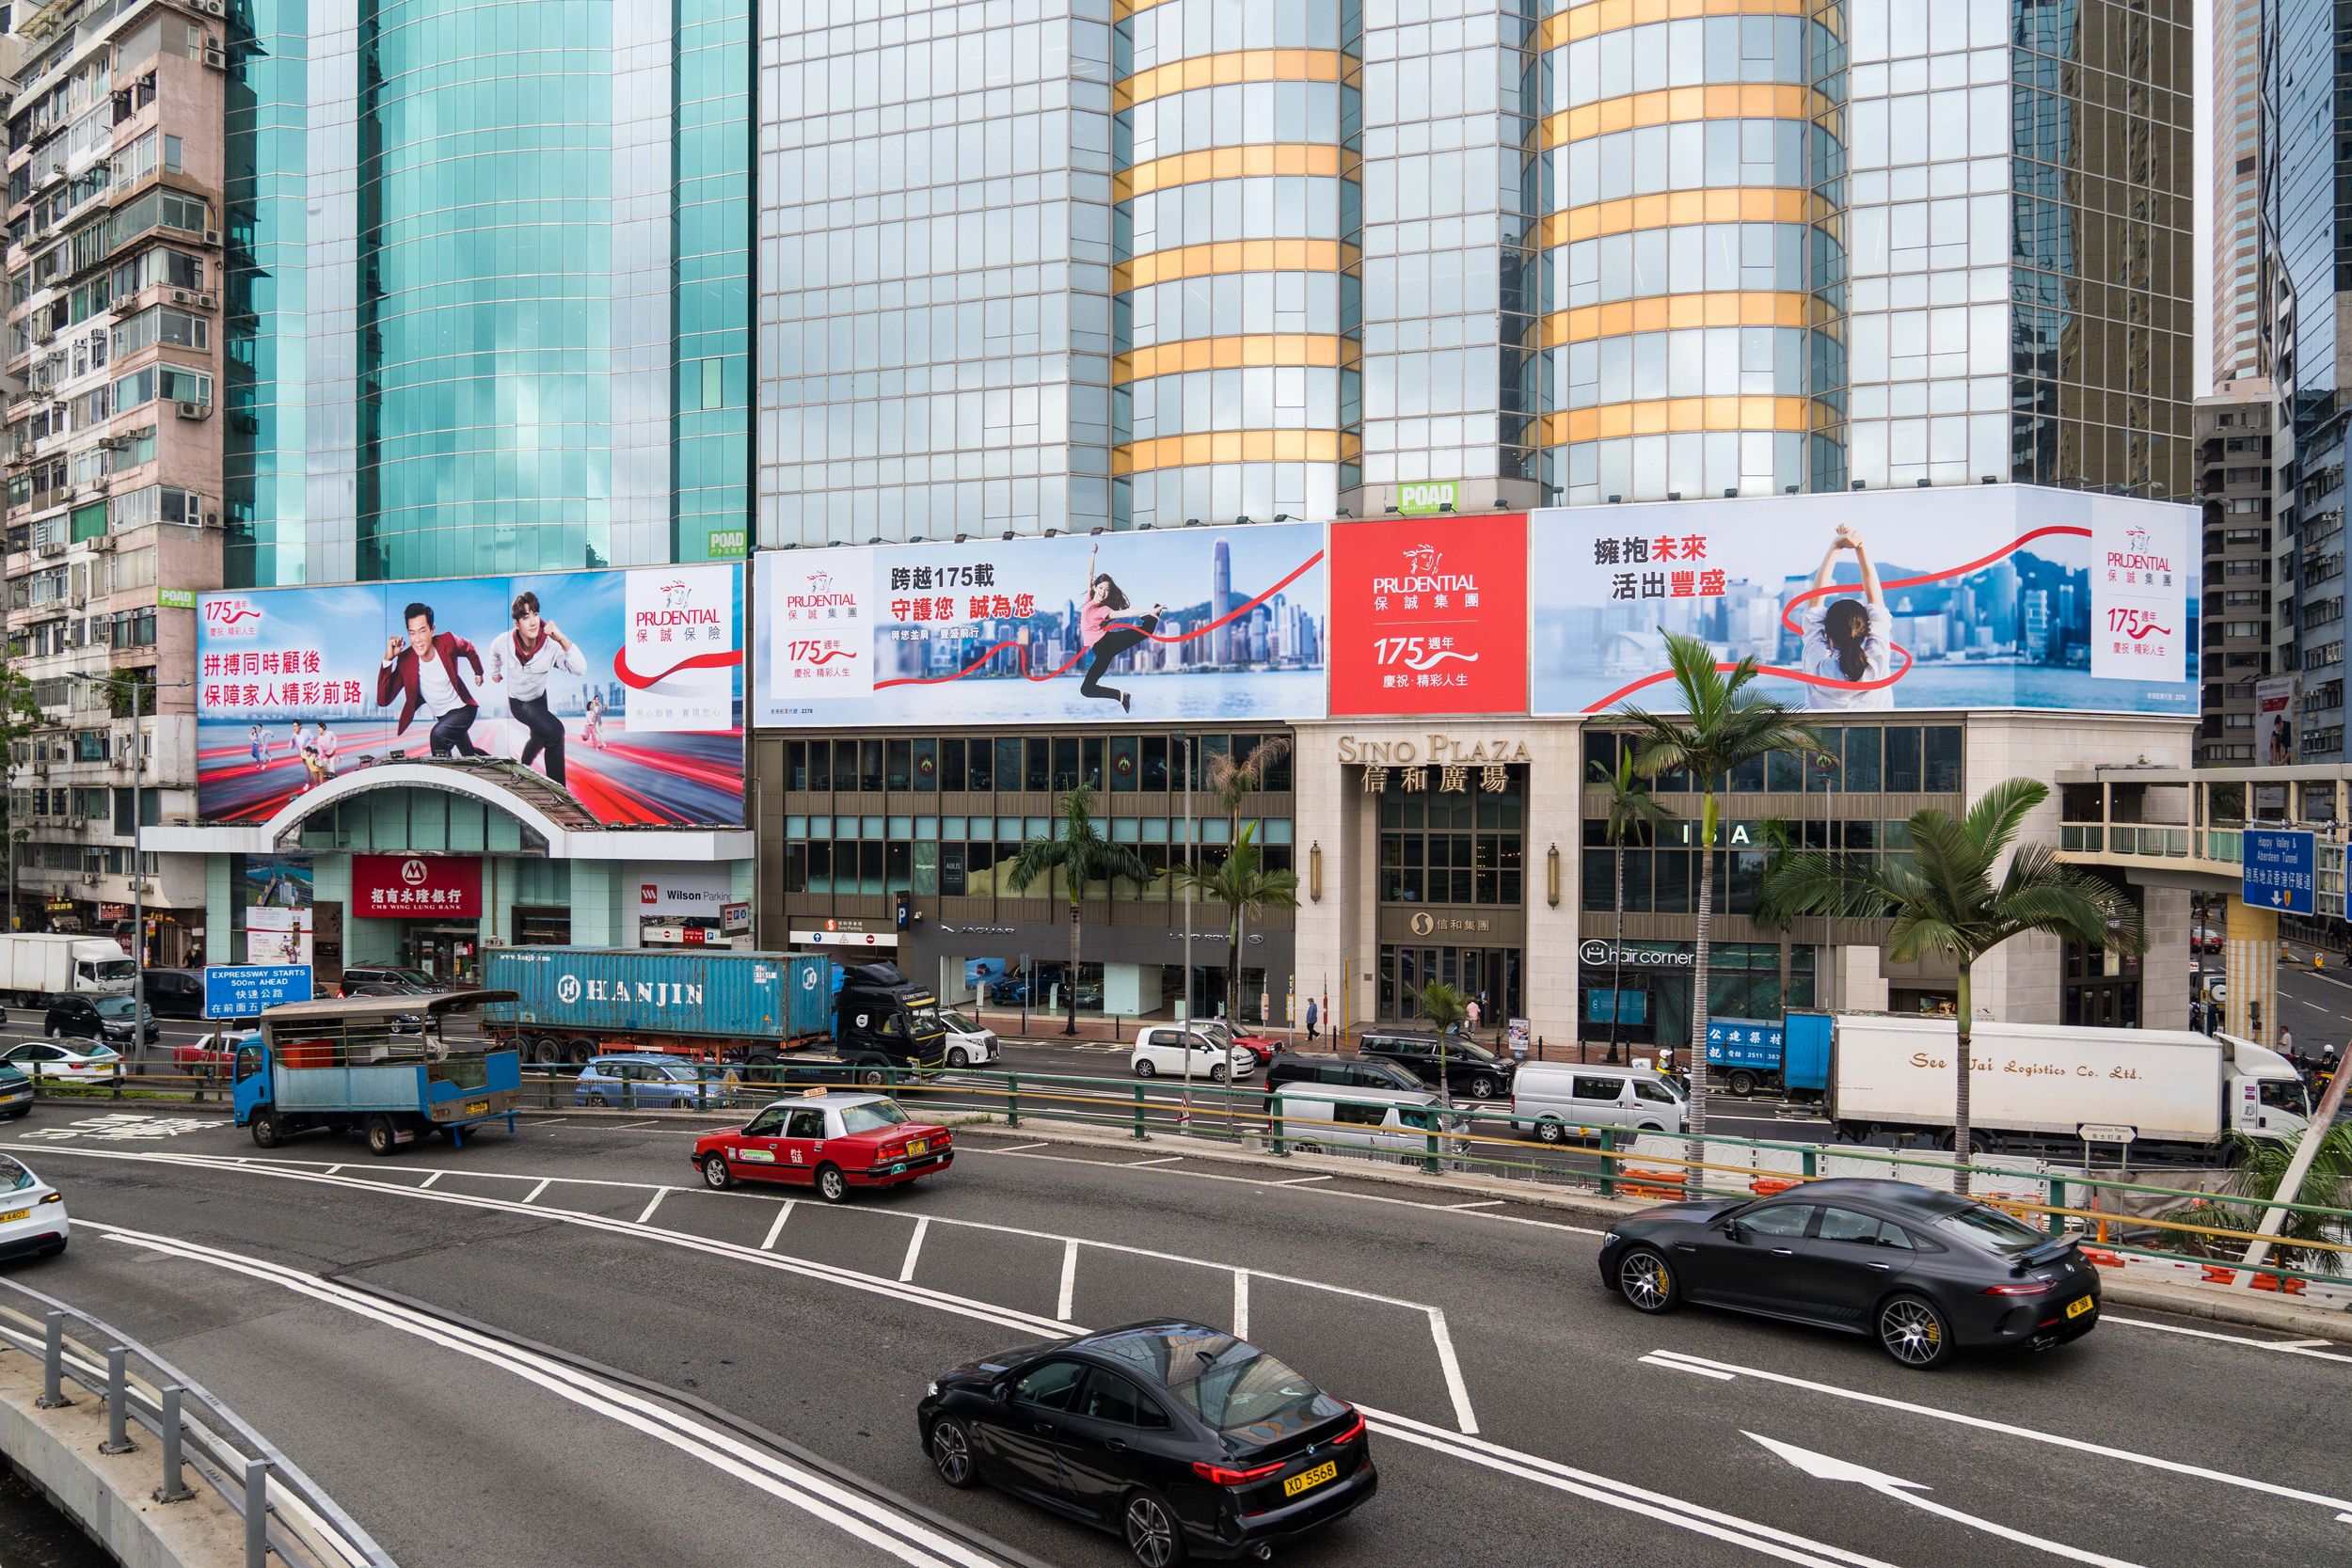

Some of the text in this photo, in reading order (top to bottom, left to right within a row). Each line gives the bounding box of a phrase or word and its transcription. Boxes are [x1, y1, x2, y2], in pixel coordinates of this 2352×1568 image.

[1403, 484, 1454, 506] POAD
[711, 531, 743, 548] POAD
[1594, 534, 1708, 565] 擁抱未來
[2107, 552, 2171, 572] PRUDENTIAL
[891, 562, 994, 592] 跨越175載
[1374, 575, 1478, 594] PRUDENTIAL
[1612, 568, 1726, 600] 活出豐盛
[2107, 569, 2171, 587] 保誠集團
[161, 590, 192, 602] POAD
[787, 593, 856, 608] PRUDENTIAL
[1374, 594, 1479, 611] 保誠集團
[787, 607, 857, 621] 保誠集團
[891, 593, 1035, 622] 守護您 誠為您
[636, 609, 720, 626] PRUDENTIAL
[636, 626, 721, 643] 保誠保險
[1428, 636, 1454, 650] 週年
[204, 650, 321, 677] 拼搏同時顧後
[204, 680, 362, 707] 保障家人精彩前路
[1361, 766, 1509, 794] 信和廣場
[2258, 837, 2272, 849] Happy
[2276, 837, 2289, 850] Valley
[2257, 850, 2298, 863] Aberdeen Tunnel
[371, 888, 462, 903] 招商永隆銀行
[667, 890, 701, 900] Wilson
[898, 908, 906, 923] P
[958, 927, 1015, 935] JAGUAR
[1437, 919, 1489, 931] 信和集團
[1169, 932, 1200, 941] LAD
[1640, 952, 1694, 965] corner
[235, 989, 283, 999] 快速公路
[586, 979, 704, 1006] HANJIN
[1909, 1053, 1947, 1068] See
[2004, 1060, 2066, 1077] Logistics
[2076, 1065, 2098, 1077] Co.
[2109, 1066, 2142, 1080] Ltd.
[791, 1155, 803, 1164] TAXI
[7, 1211, 25, 1221] 4407
[1287, 1465, 1334, 1494] XD 5568
